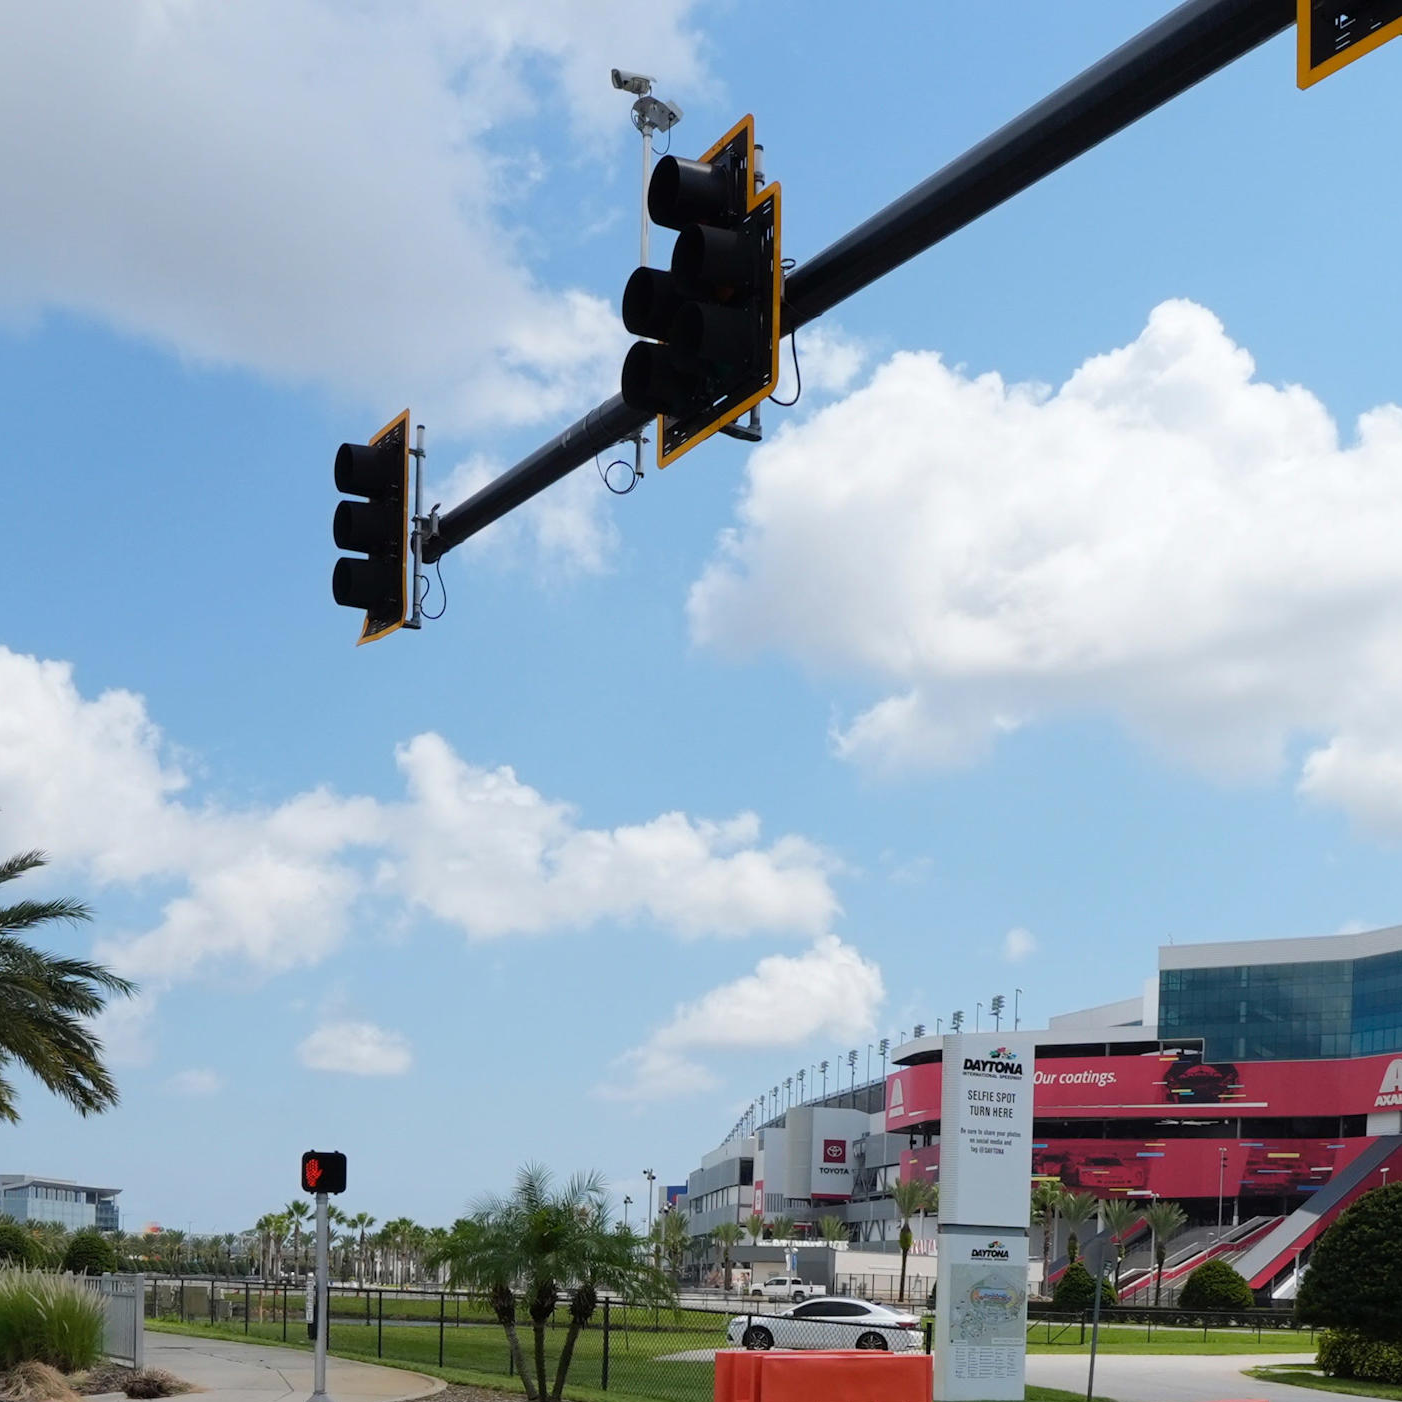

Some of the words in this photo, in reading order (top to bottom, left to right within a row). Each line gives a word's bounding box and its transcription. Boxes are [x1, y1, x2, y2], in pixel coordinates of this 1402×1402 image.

[963, 1058, 1023, 1076] DAYTONA
[1033, 1071, 1057, 1085] Our
[1059, 1070, 1117, 1087] coatings.
[967, 1090, 994, 1102] SELFIE
[996, 1092, 1016, 1104] SPOT
[969, 1105, 990, 1117] TURN
[992, 1107, 1014, 1119] HERE
[819, 1167, 850, 1175] TOYOTA
[971, 1249, 1009, 1258] DAYTONA
